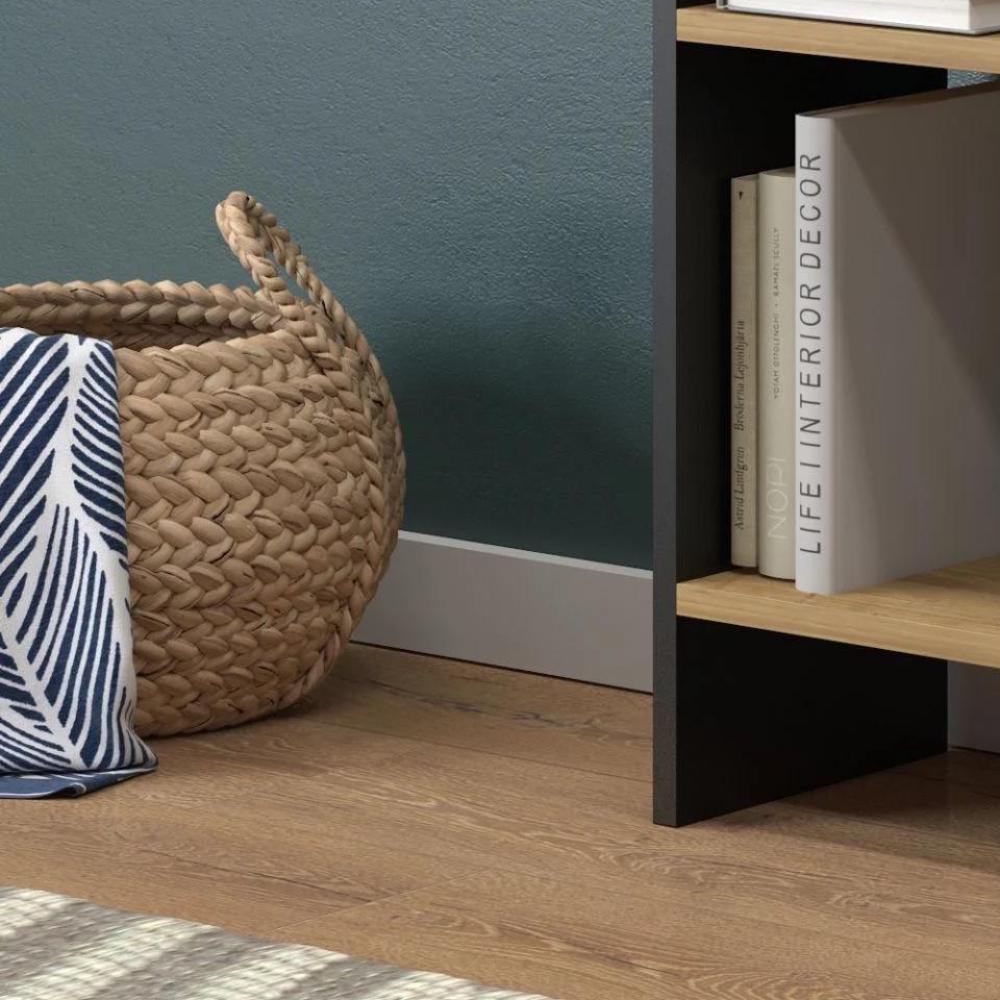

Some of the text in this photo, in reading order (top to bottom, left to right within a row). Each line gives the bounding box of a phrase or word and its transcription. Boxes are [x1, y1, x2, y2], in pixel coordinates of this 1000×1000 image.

[799, 153, 821, 269] DECOR
[799, 282, 821, 448] INTERIOR
[733, 498, 745, 530] Astrid
[766, 456, 789, 540] NOPI
[799, 482, 821, 555] LIFE
